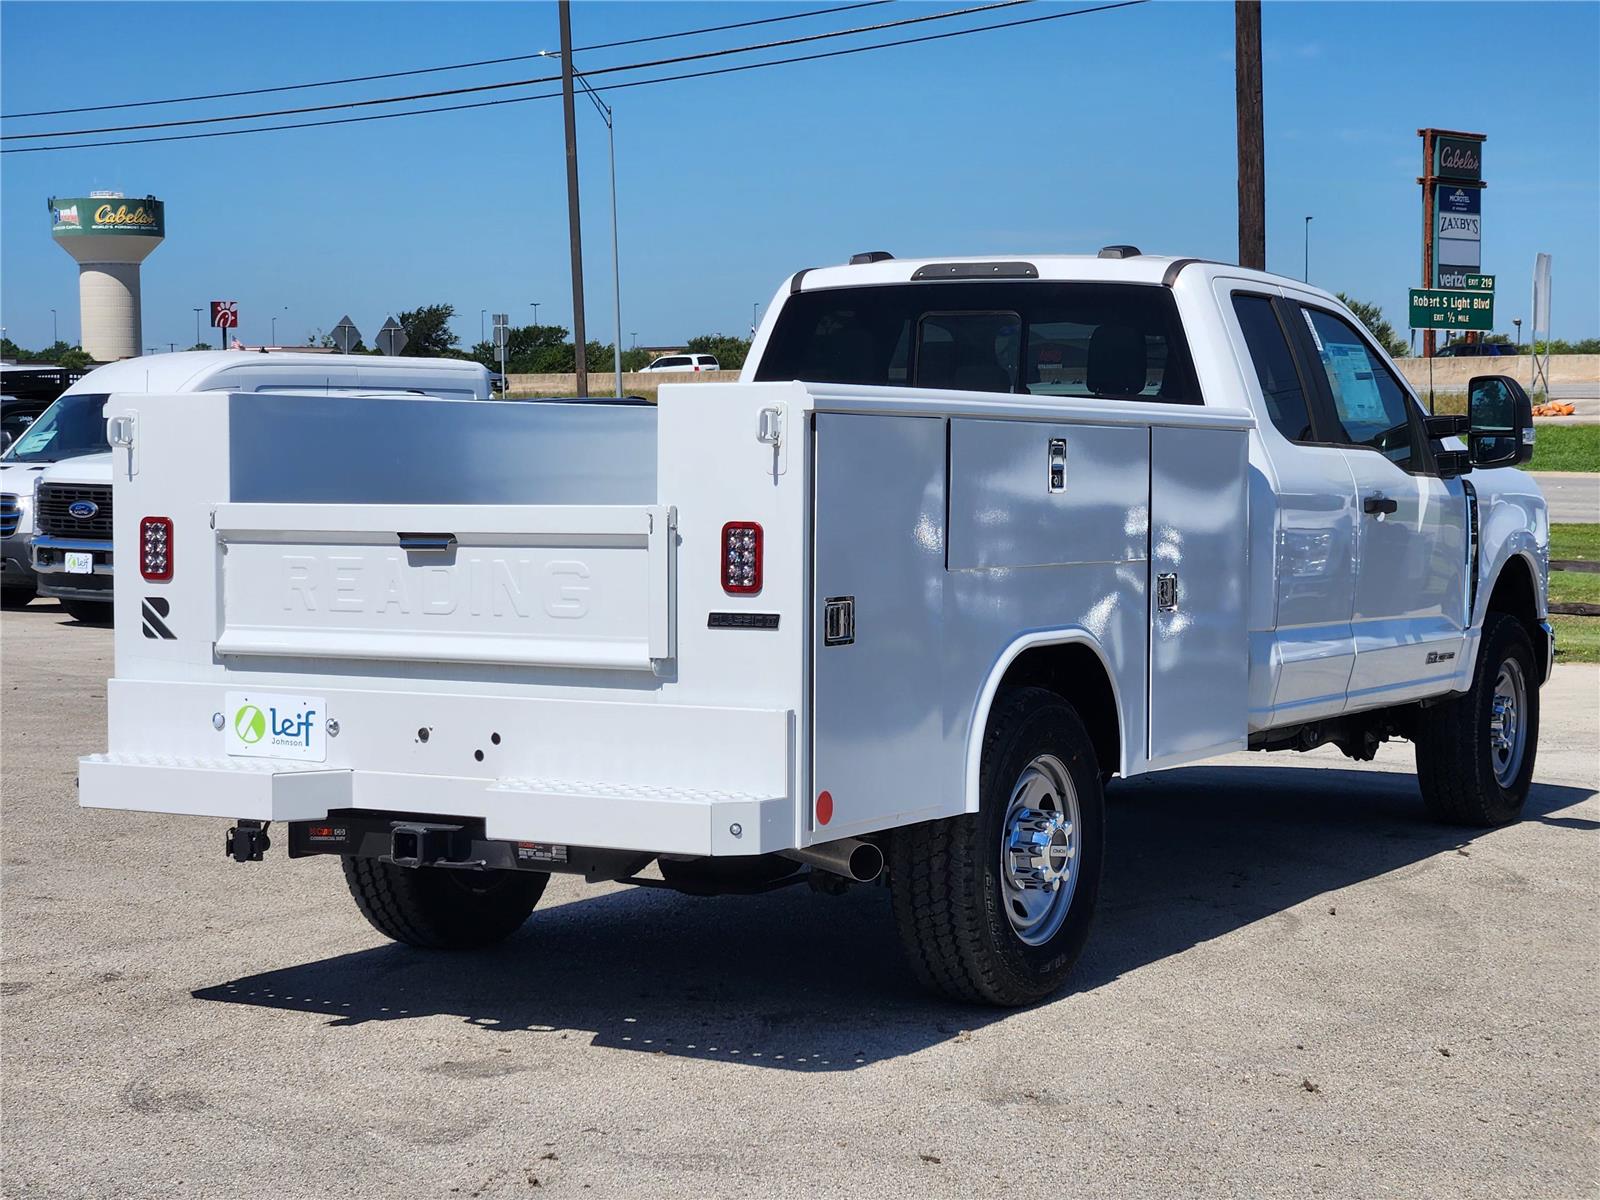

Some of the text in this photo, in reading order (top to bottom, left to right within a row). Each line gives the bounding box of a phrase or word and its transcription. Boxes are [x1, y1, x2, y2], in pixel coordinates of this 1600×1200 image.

[1441, 146, 1479, 169] Cabela's
[1440, 216, 1479, 234] ZAXBY'S
[1468, 278, 1493, 288] EXIT 219
[1413, 295, 1490, 311] Robert S Light Blvd
[1433, 313, 1445, 321] EXIT
[282, 555, 591, 619] READING
[271, 738, 303, 747] Johnson
